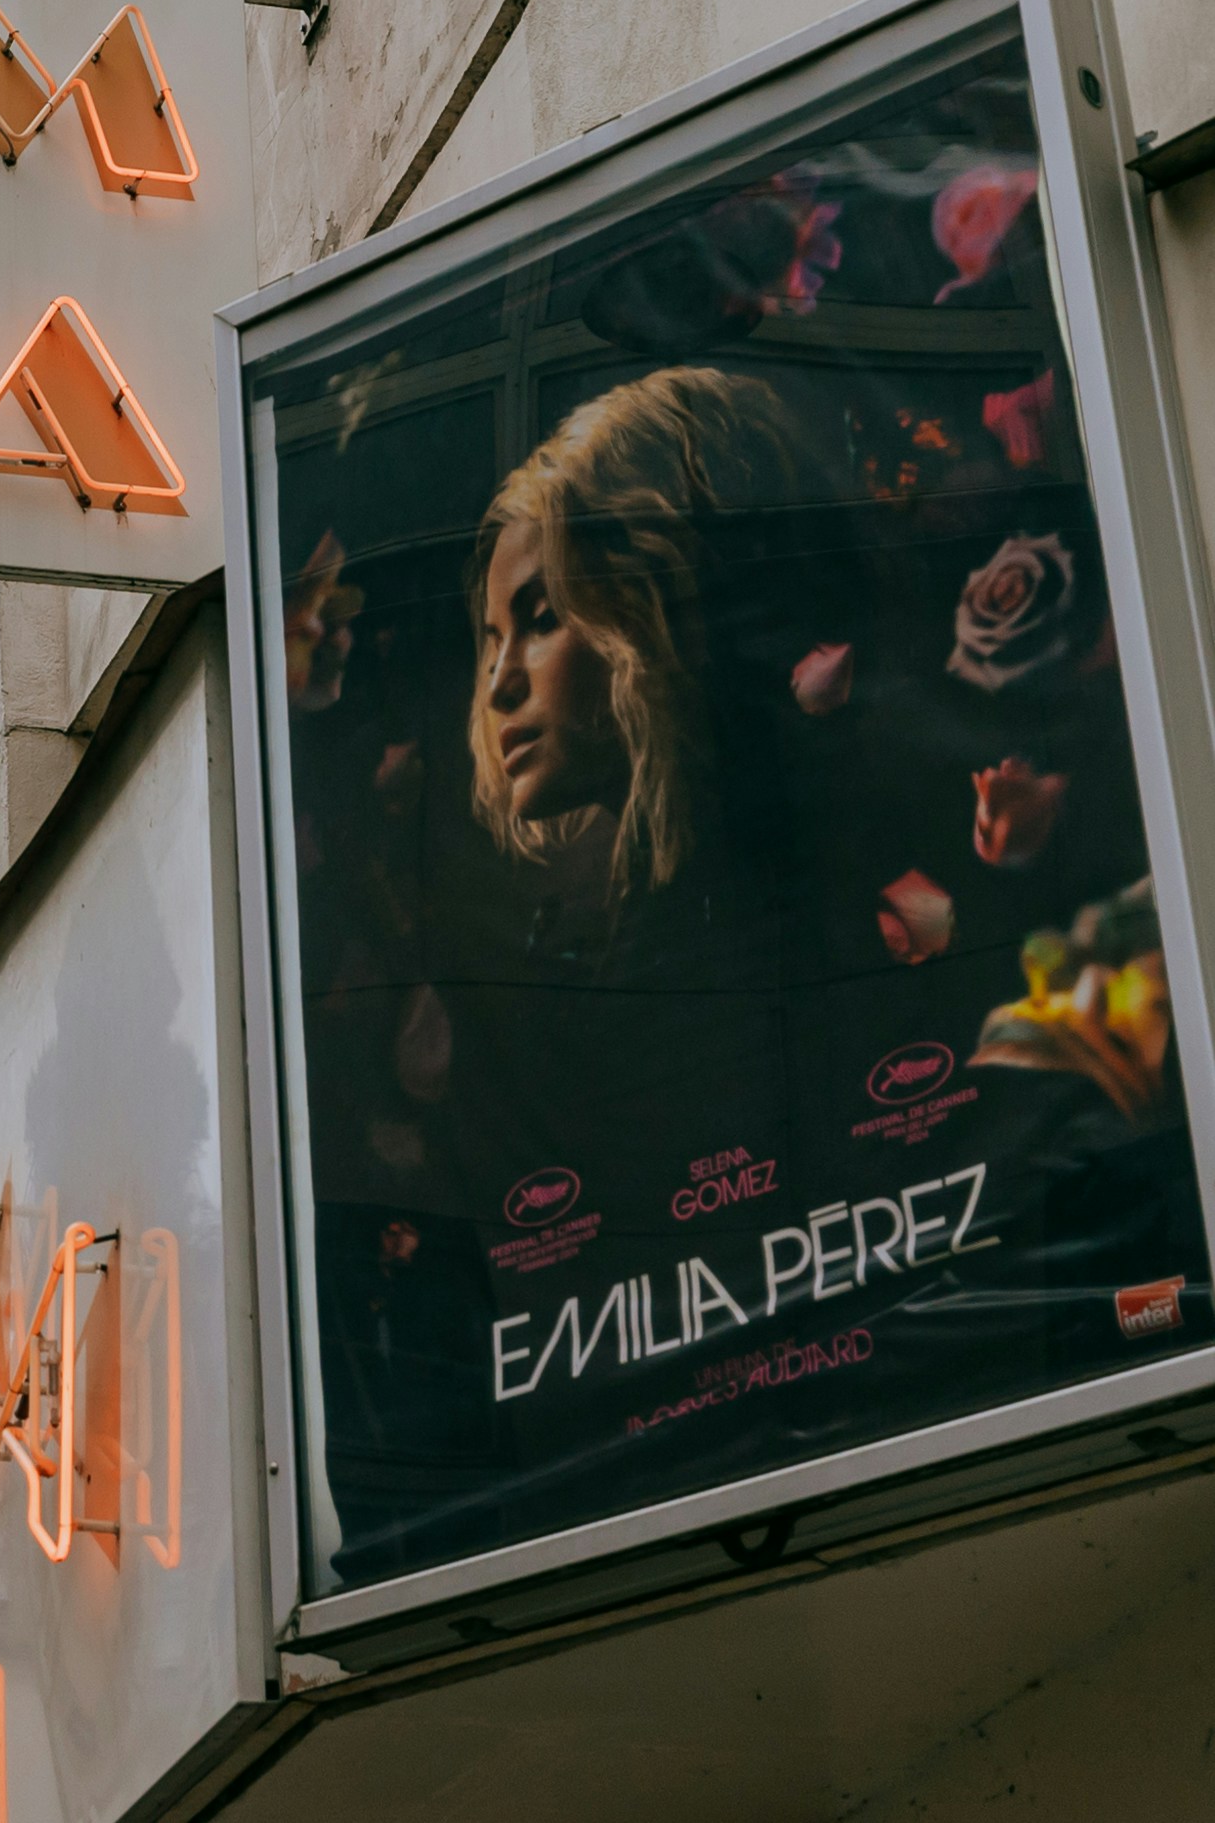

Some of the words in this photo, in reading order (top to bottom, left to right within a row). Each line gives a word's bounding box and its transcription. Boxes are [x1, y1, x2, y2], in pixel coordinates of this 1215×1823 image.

[850, 1112, 905, 1137] FESTIVAL
[907, 1104, 926, 1120] DE
[927, 1087, 980, 1113] CANNES
[689, 1145, 752, 1183] SELENA
[671, 1159, 779, 1222] GOMEZ
[492, 1256, 750, 1403] EMILIA
[1122, 1304, 1173, 1332] inter
